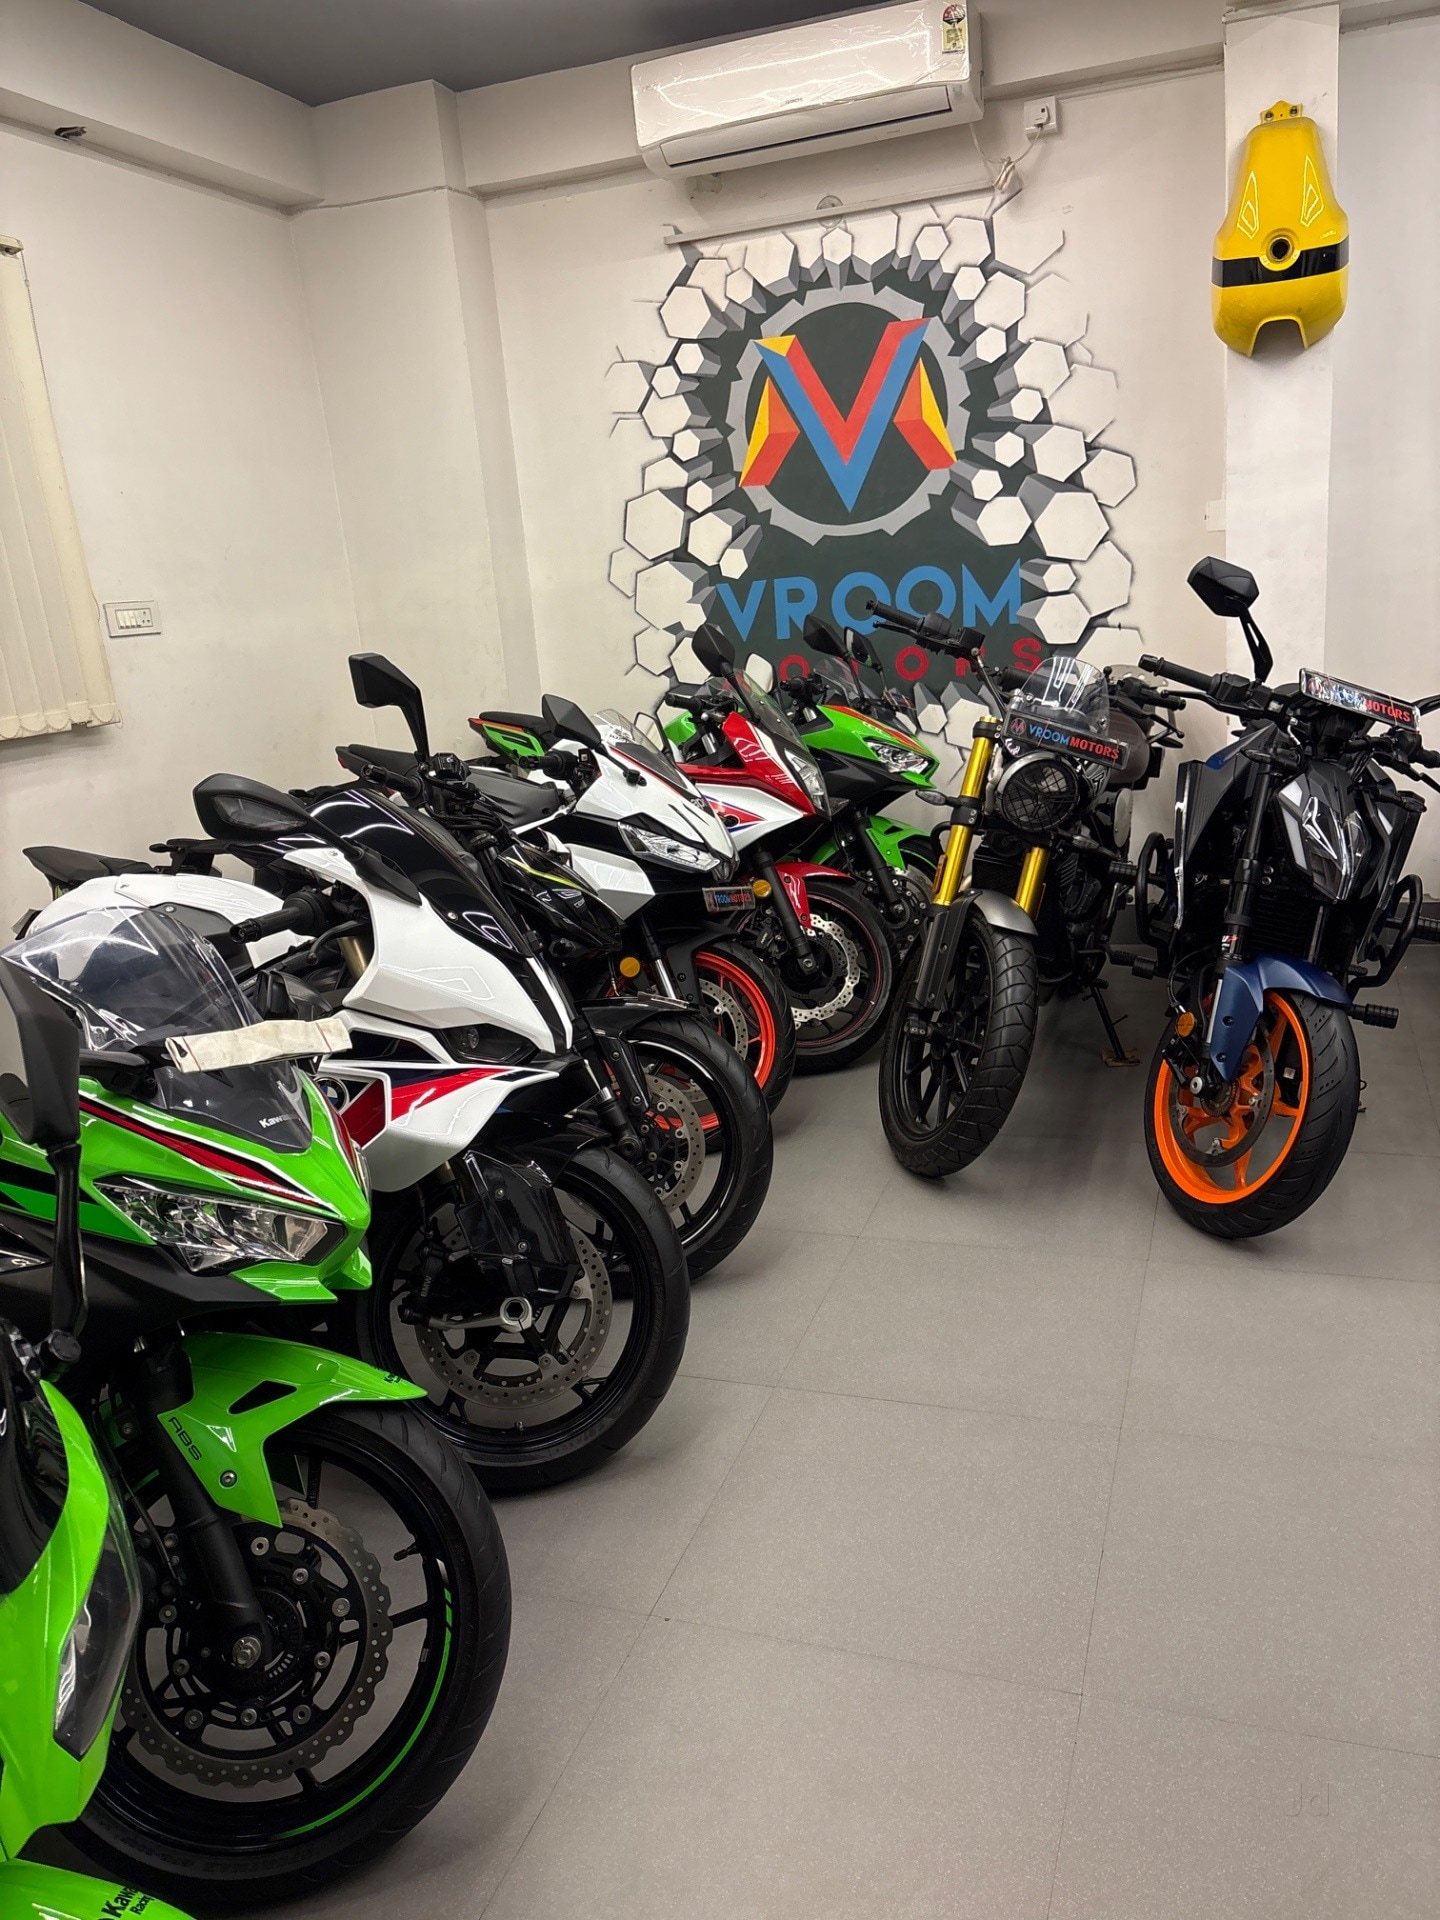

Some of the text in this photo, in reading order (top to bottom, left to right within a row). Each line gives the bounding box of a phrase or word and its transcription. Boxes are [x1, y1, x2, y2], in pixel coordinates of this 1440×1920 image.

[716, 558, 1021, 642] VROOM
[420, 1275, 432, 1297] BMW
[169, 1416, 202, 1460] ABS
